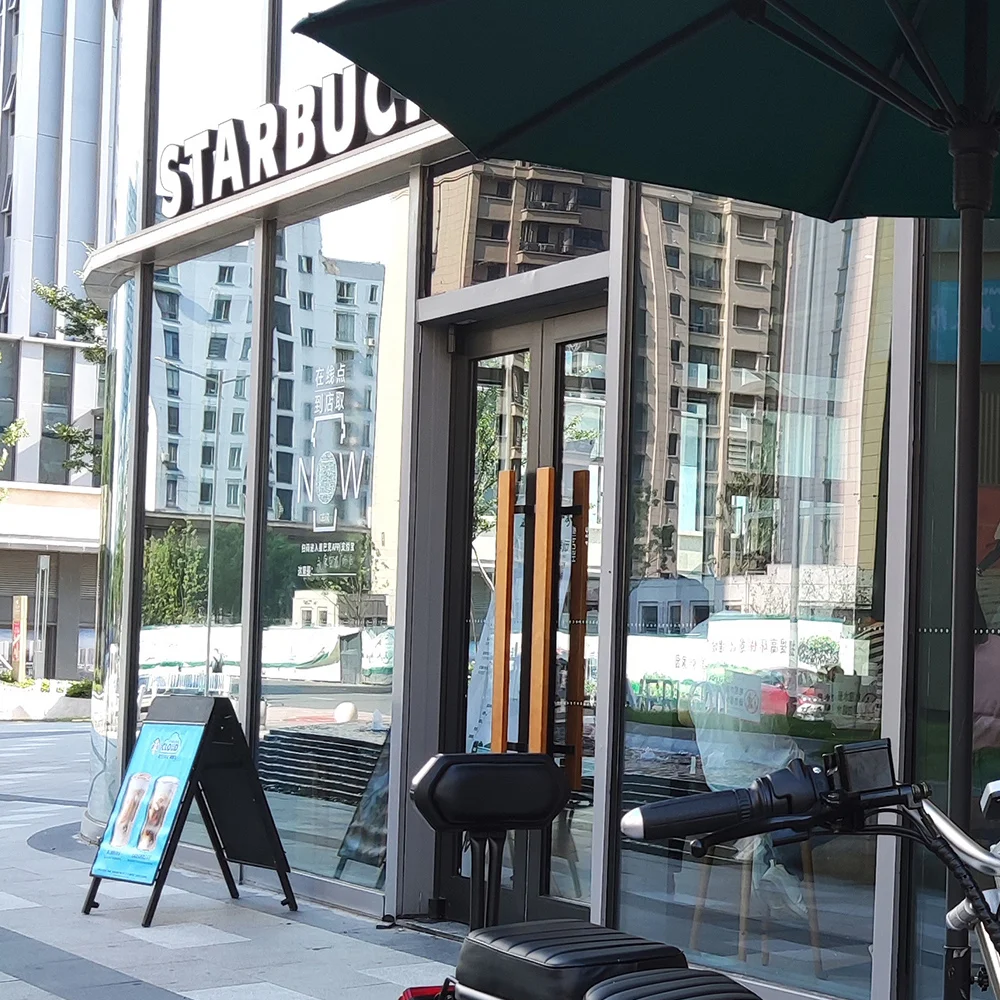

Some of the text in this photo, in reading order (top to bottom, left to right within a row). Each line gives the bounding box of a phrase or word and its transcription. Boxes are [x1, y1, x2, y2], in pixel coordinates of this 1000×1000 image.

[156, 63, 421, 218] STARBUC
[315, 363, 346, 386] 在线点
[314, 391, 345, 414] 到店取
[297, 449, 365, 505] NOW
